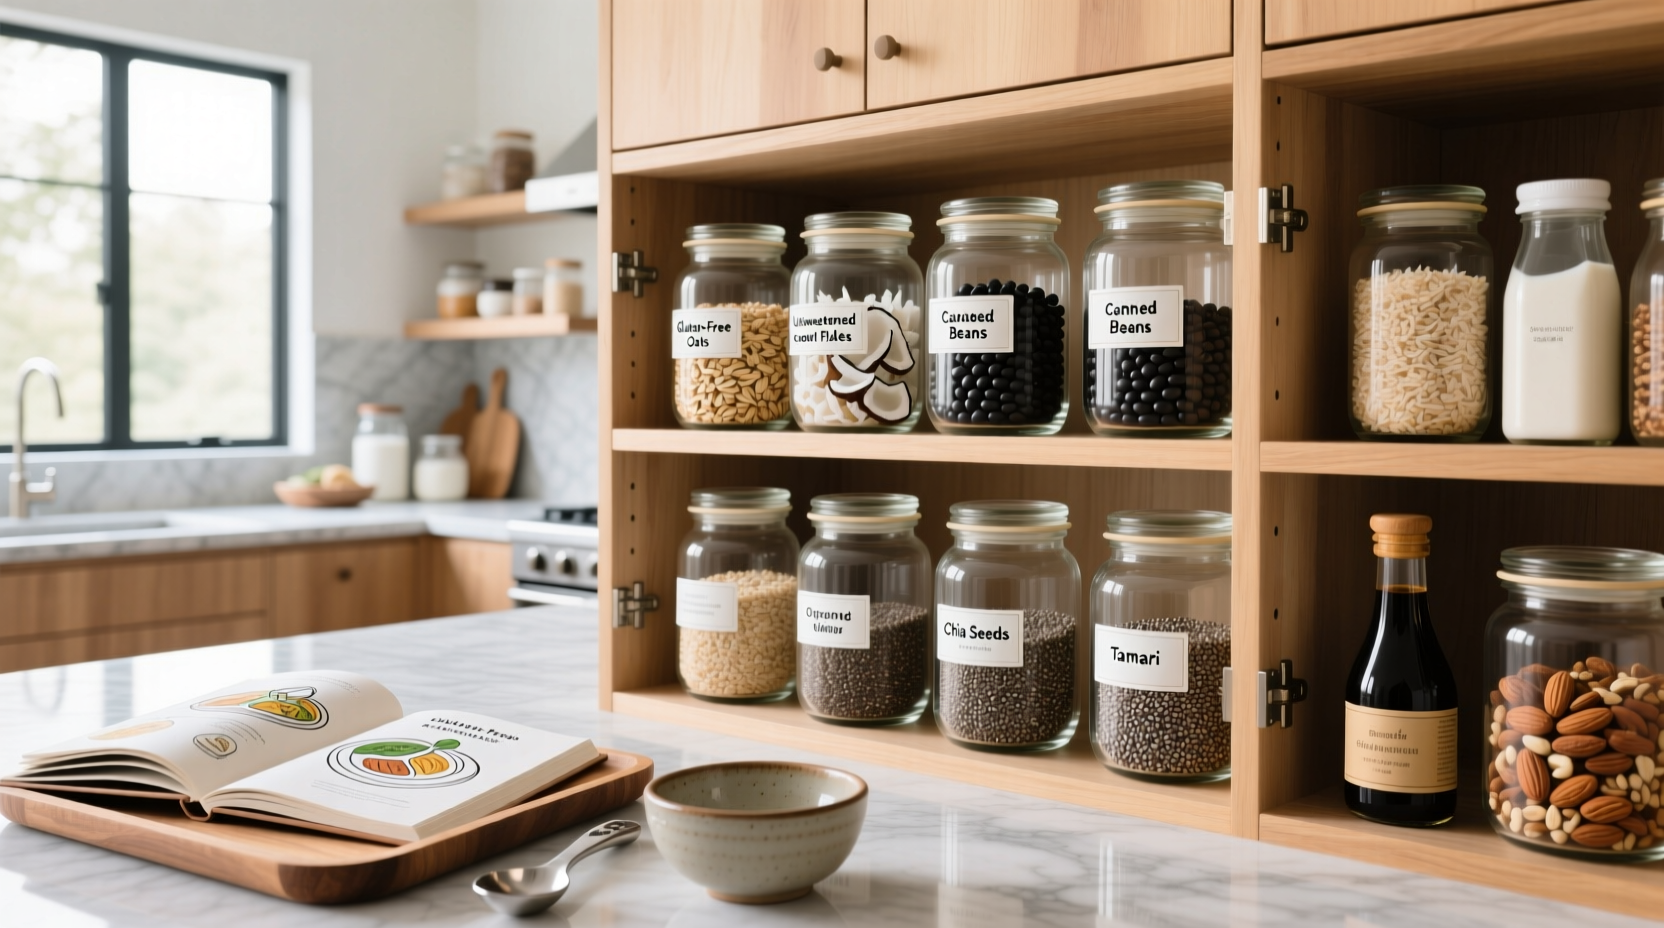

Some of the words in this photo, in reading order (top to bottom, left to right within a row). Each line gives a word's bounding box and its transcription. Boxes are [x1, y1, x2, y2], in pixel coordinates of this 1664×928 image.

[950, 326, 988, 340] Beans
[1110, 320, 1152, 334] Beans
[944, 621, 966, 639] Chia
[969, 625, 1010, 640] Seeds
[1110, 646, 1160, 665] Tamari
